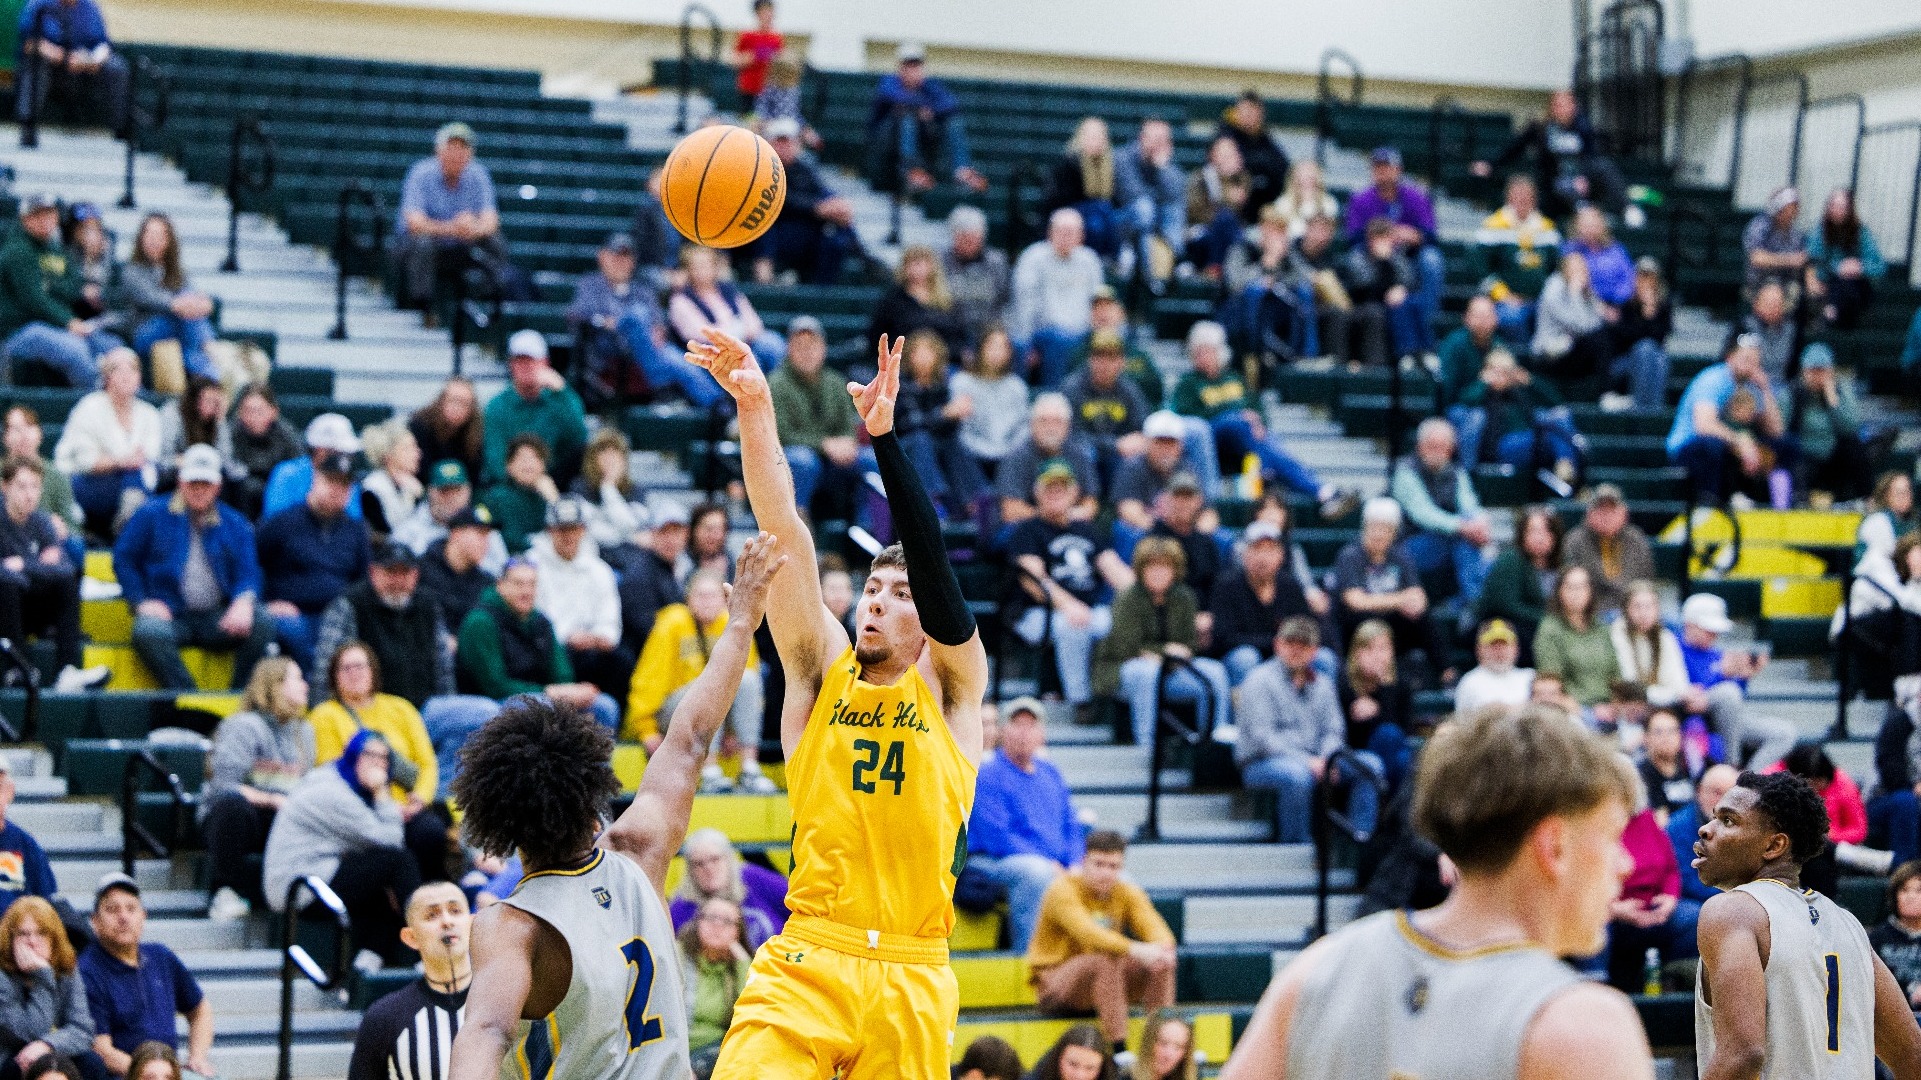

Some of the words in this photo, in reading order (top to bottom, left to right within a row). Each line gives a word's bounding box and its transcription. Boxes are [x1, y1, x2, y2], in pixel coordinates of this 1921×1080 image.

[740, 155, 780, 230] Wilson
[852, 738, 906, 796] 24
[617, 935, 666, 1055] 2
[1823, 952, 1842, 1055] 1
